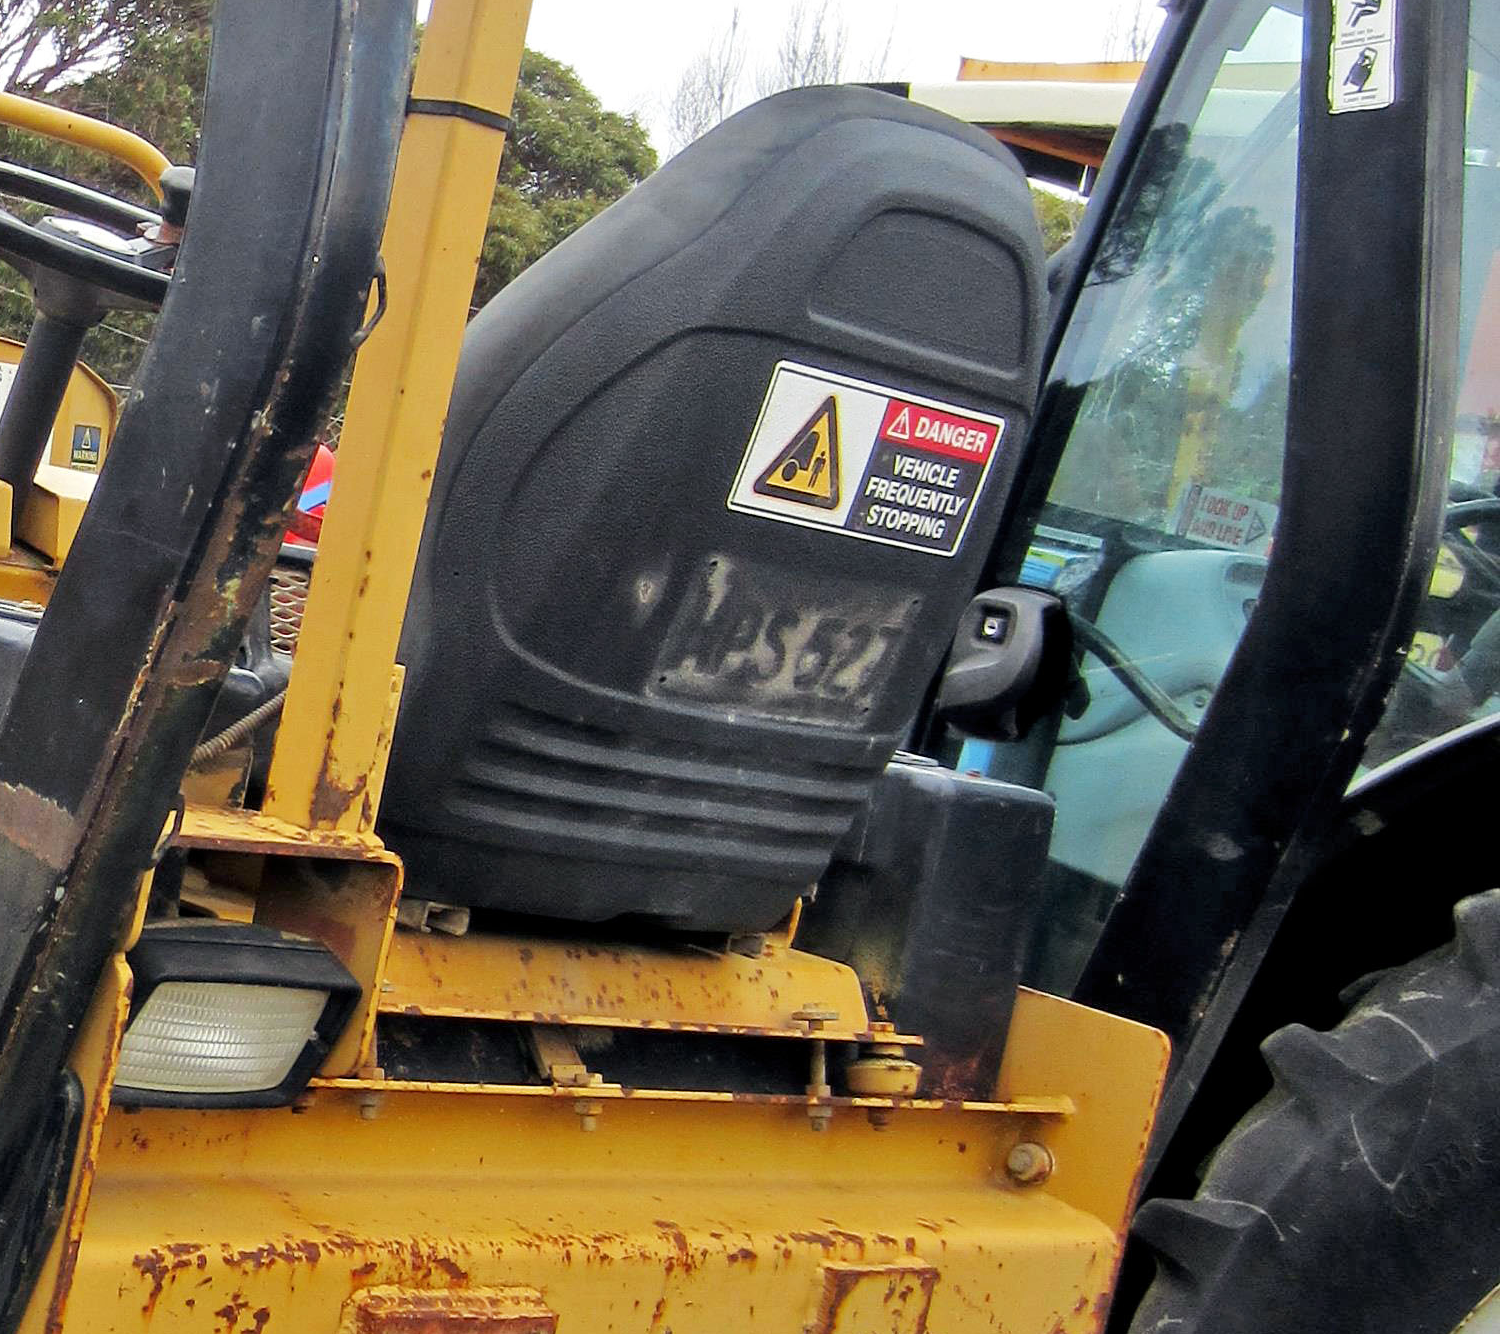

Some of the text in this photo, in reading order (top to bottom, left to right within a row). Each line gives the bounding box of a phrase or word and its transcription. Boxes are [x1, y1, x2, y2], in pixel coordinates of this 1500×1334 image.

[915, 417, 988, 453] DANGER
[892, 454, 960, 489] VEHICLE
[865, 477, 966, 517] FREQUENTLY
[866, 505, 946, 540] STOPPING
